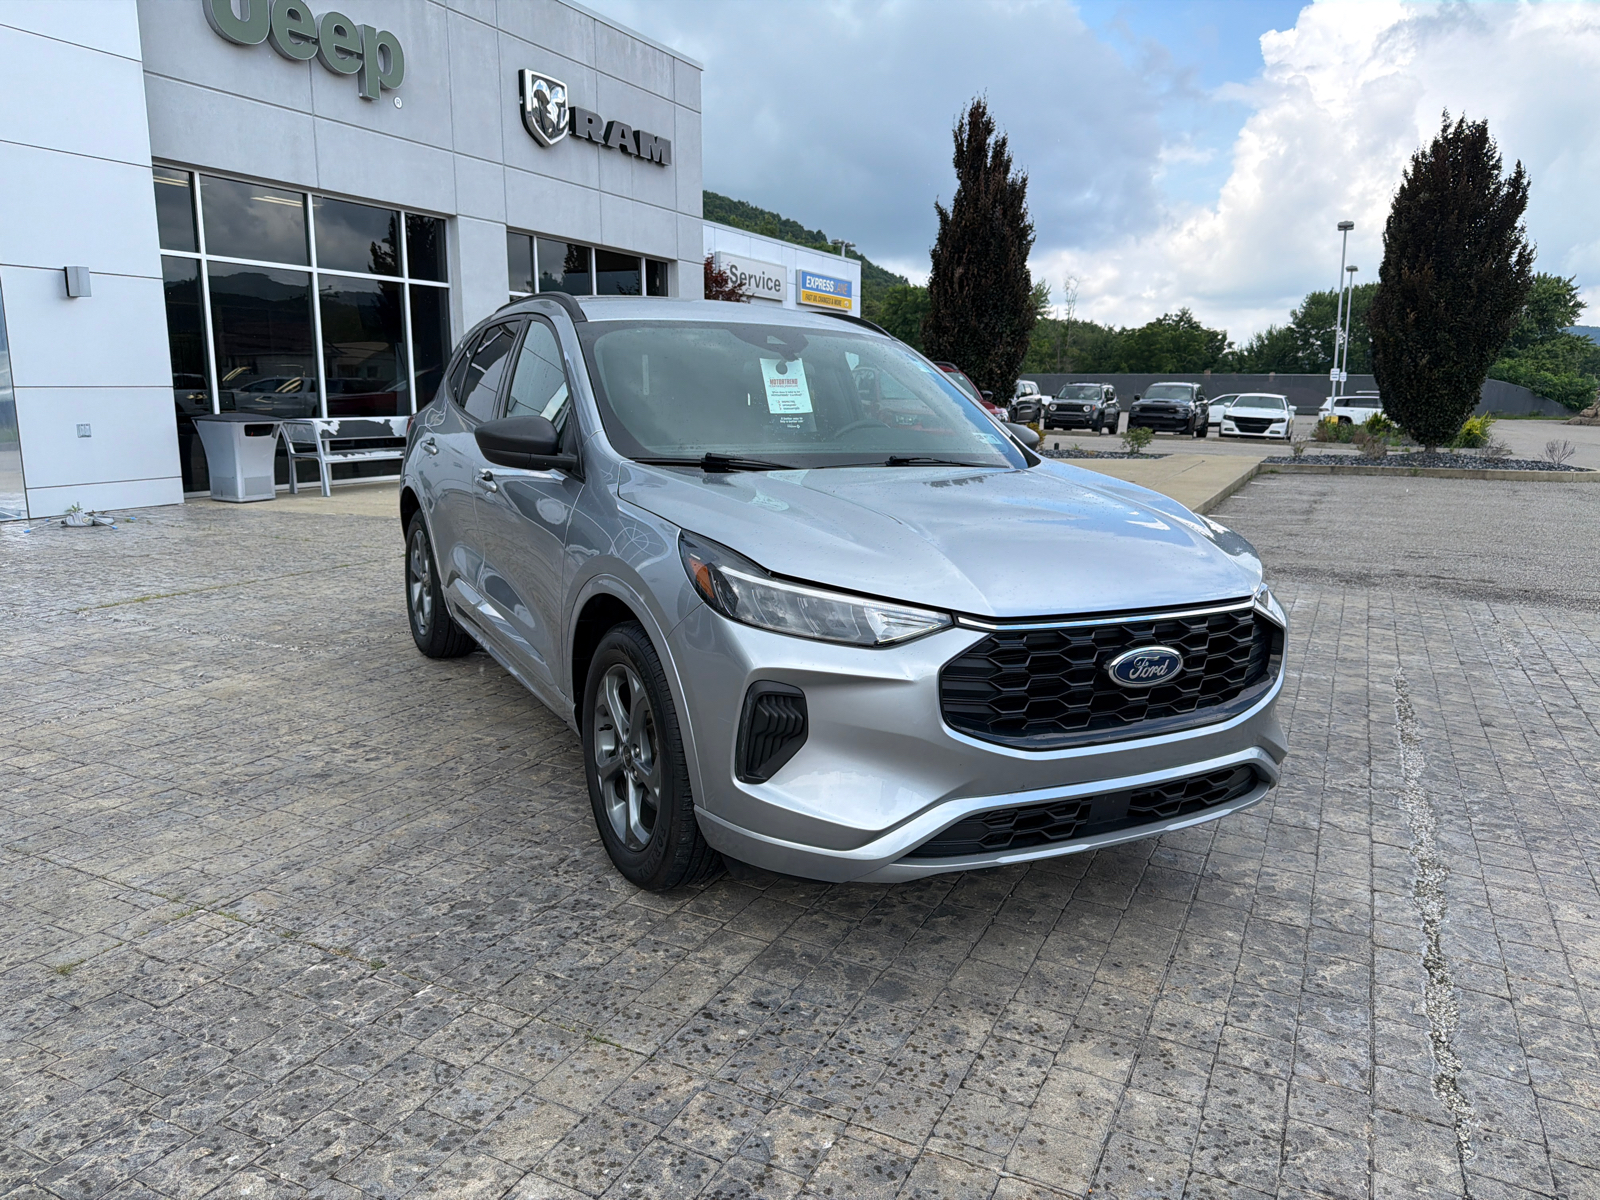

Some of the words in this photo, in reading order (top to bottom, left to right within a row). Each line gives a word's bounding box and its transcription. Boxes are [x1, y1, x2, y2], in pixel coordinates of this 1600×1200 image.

[569, 106, 672, 166] RAM
[729, 264, 782, 292] Service
[1129, 655, 1170, 679] Ford
